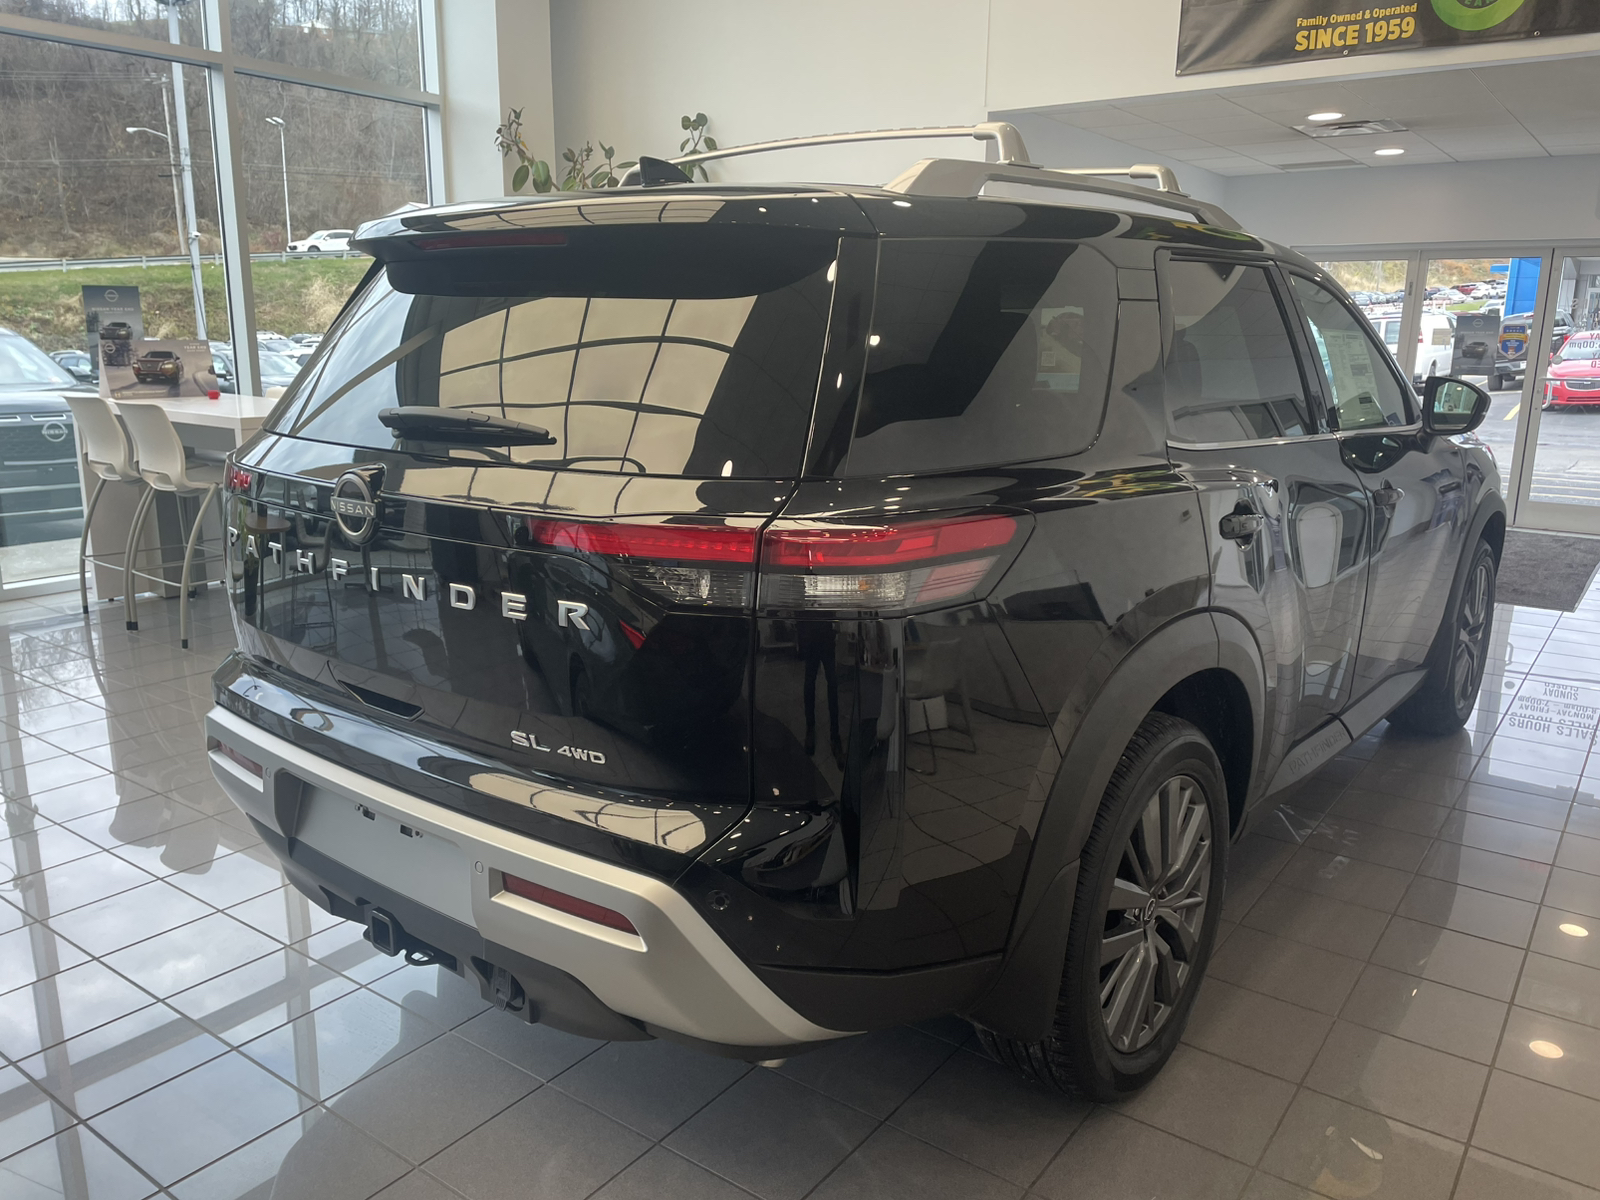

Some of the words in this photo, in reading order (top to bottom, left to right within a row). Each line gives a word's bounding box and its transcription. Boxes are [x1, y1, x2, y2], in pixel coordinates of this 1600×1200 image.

[1296, 15, 1328, 27] Family
[1330, 11, 1362, 24] Owned
[1364, 10, 1371, 19] &
[1373, 3, 1418, 18] Operated
[1294, 24, 1358, 51] SINCE
[1365, 16, 1416, 43] 1959
[330, 496, 375, 518] NISSAN
[227, 526, 591, 631] PATHFINDER
[1508, 717, 1550, 733] HOURS
[510, 730, 551, 753] SL
[557, 745, 607, 766] 4WD
